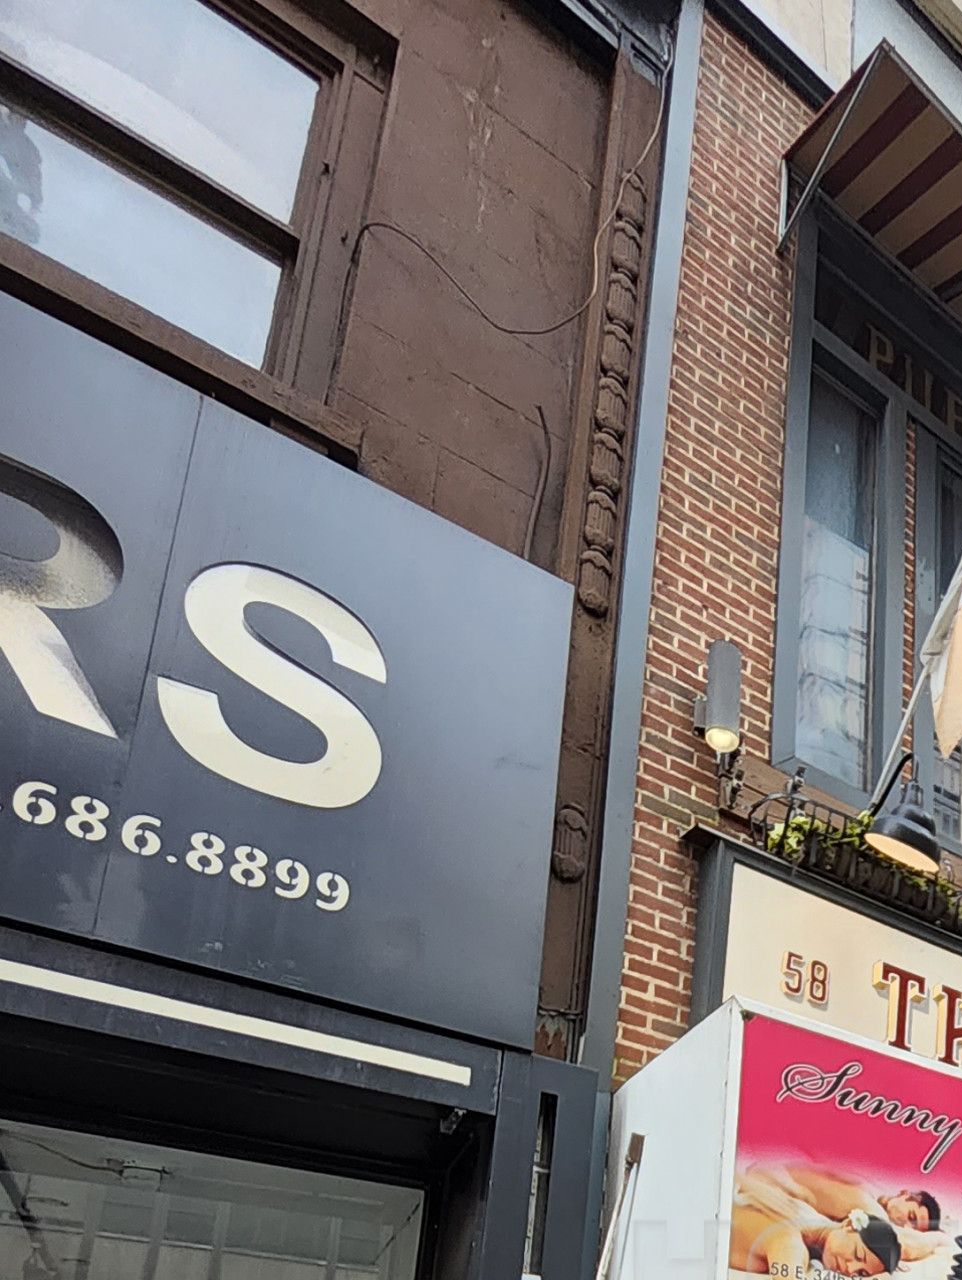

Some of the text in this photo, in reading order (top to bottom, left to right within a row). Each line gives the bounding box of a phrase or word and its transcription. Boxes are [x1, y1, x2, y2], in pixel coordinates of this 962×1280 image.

[12, 780, 350, 913] 686.8899
[781, 951, 830, 1004] 58
[770, 1262, 789, 1278] 58
[795, 1265, 808, 1280] E.
